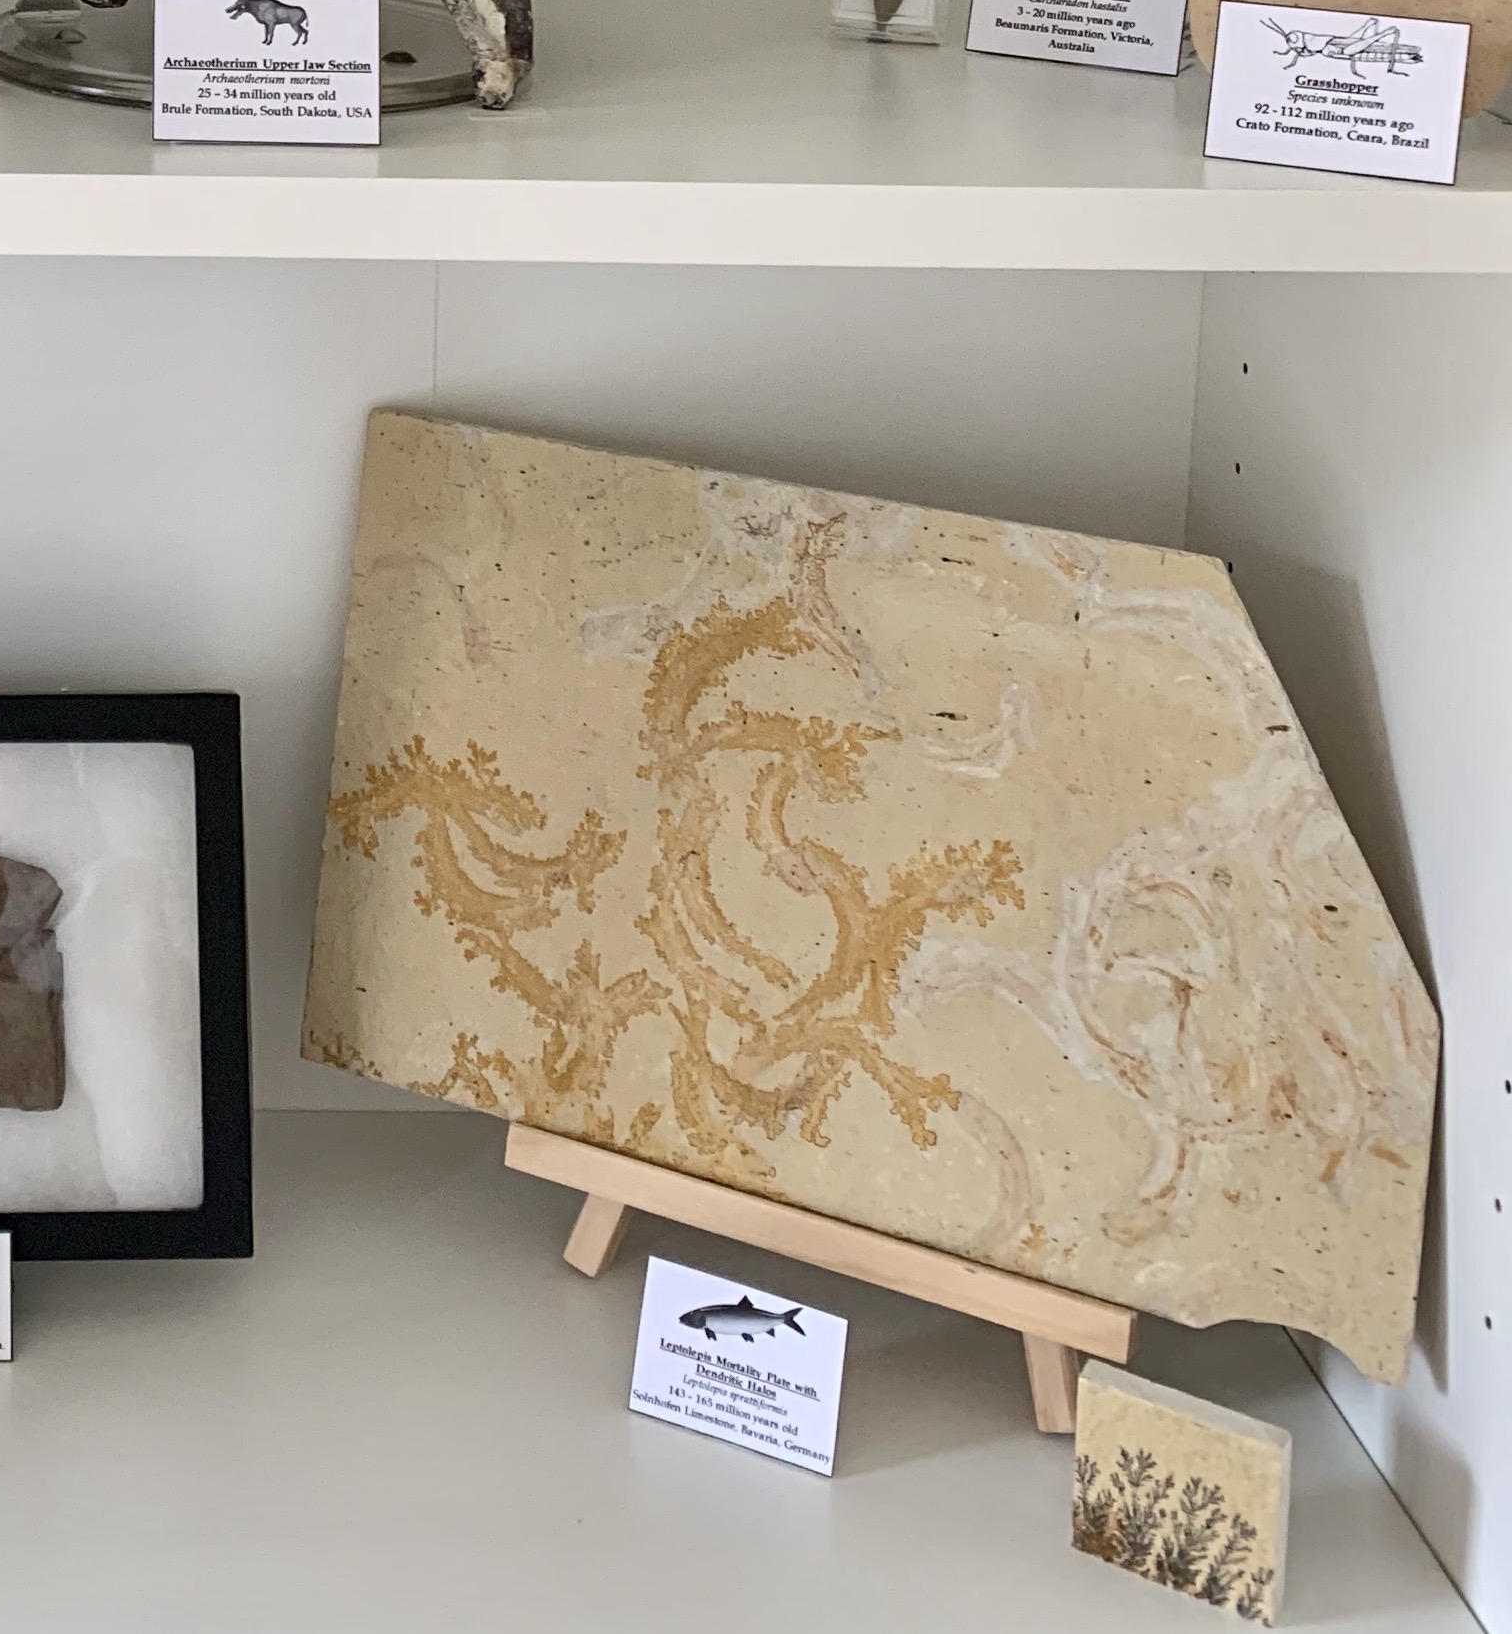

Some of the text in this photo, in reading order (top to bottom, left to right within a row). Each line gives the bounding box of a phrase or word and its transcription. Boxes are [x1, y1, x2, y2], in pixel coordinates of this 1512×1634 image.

[1091, 1, 1127, 12] hastalis
[1017, 7, 1135, 30] 3 20 million years ago
[996, 18, 1154, 46] Beaumaris Formation, Victoria,
[1049, 39, 1095, 52] Australia
[164, 57, 370, 71] Archaeotherium Upper Jaw Section
[203, 73, 330, 84] Archaeotherium mortoni
[1295, 75, 1378, 94] Grasshopper
[198, 89, 335, 102] 25 34 million years old
[1288, 90, 1384, 110] Species unknown
[162, 104, 372, 118] Brule Formation, South Dakota, USA
[1255, 103, 1413, 132] 92 112 million years ago
[1236, 118, 1429, 149] Crato Formation, Ceara, Brazil
[660, 1338, 817, 1397] Leptolepis Mortality Plate with
[683, 1374, 727, 1398] Leptolepis
[696, 1364, 777, 1398] Dendritic Halos
[669, 1386, 798, 1436] 143 165 million years old
[633, 1389, 831, 1464] Solnhofen Limestone, Bavaria, Germany
